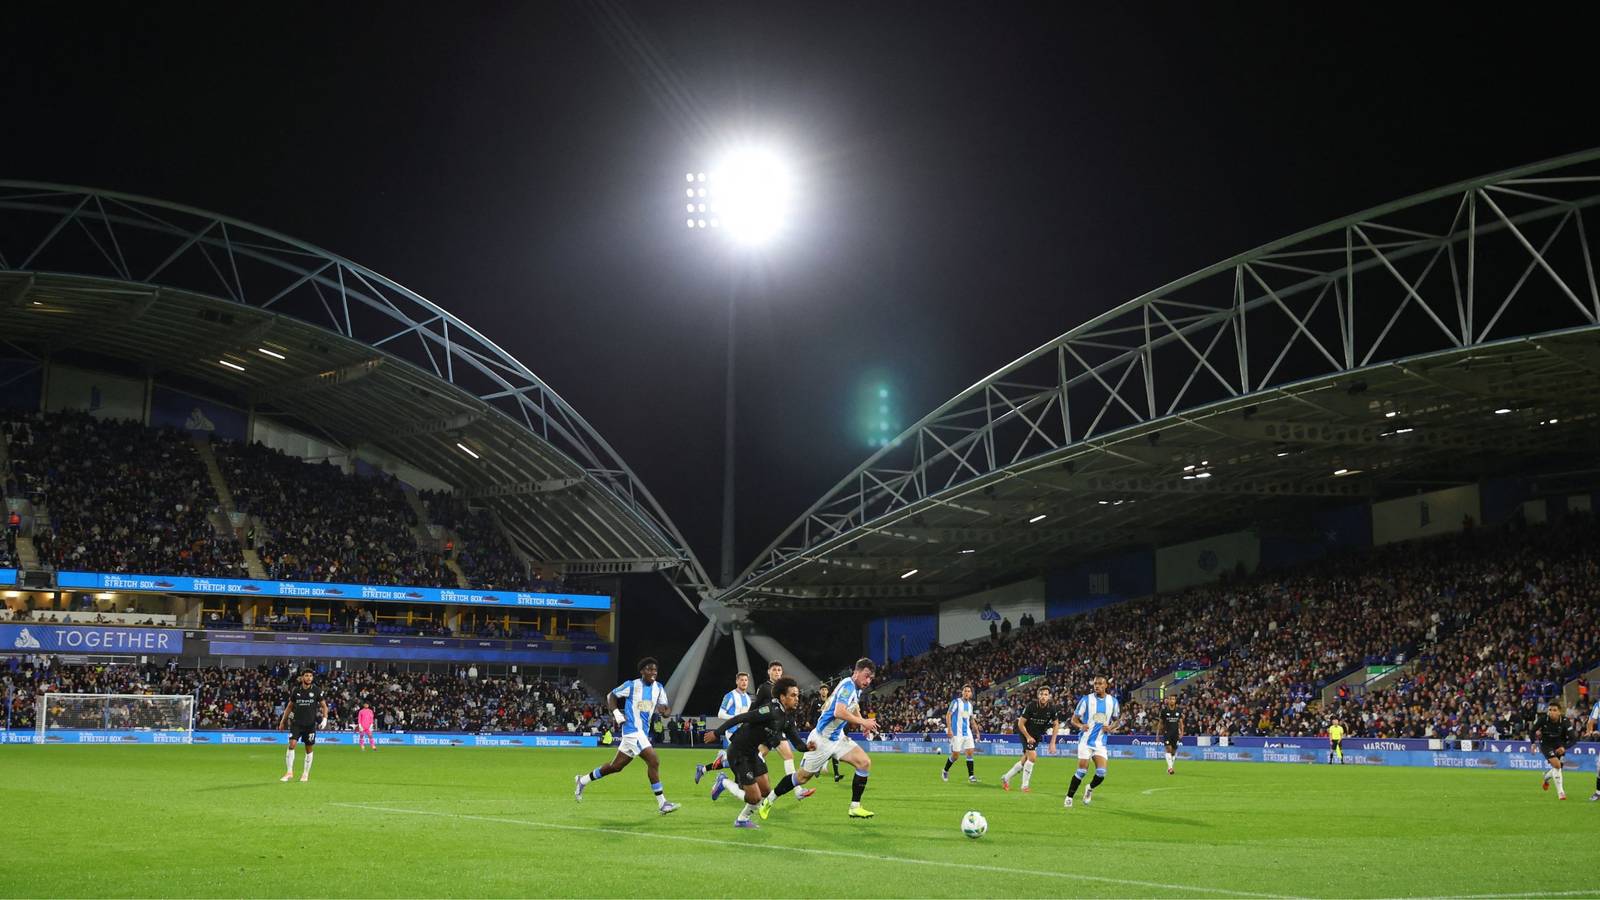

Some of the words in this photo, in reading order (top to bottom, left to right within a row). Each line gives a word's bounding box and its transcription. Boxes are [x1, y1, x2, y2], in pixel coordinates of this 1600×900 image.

[194, 583, 226, 591] STRETCH
[228, 584, 242, 592] SOX
[280, 587, 310, 595] STRETCH
[363, 590, 392, 598] STRETCH
[393, 591, 406, 599] SOX
[56, 630, 168, 649] TOGETHER
[1434, 758, 1463, 766] STRETCH
[1465, 758, 1479, 766] SOX
[1510, 760, 1542, 768] STRETCH
